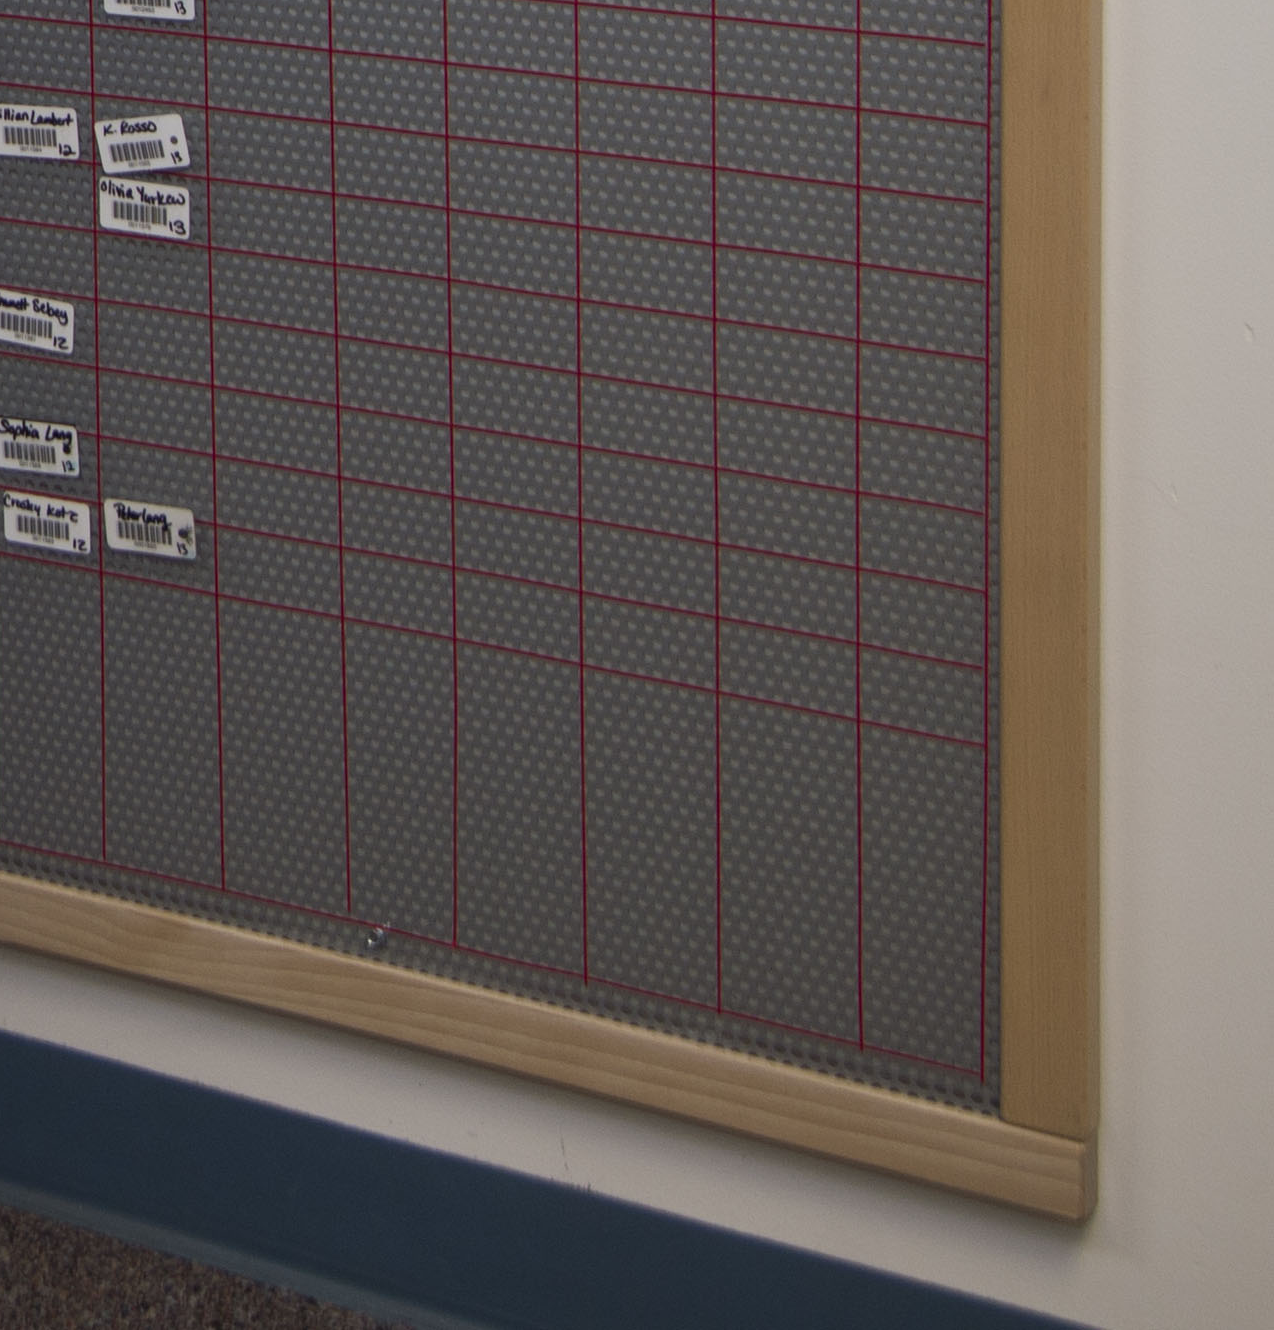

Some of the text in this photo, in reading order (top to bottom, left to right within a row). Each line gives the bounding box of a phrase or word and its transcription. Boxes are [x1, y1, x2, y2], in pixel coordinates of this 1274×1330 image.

[30, 110, 74, 127] Lambert
[58, 142, 76, 157] 12
[168, 219, 187, 236] 13
[52, 335, 69, 350] 12
[72, 537, 87, 552] 12
